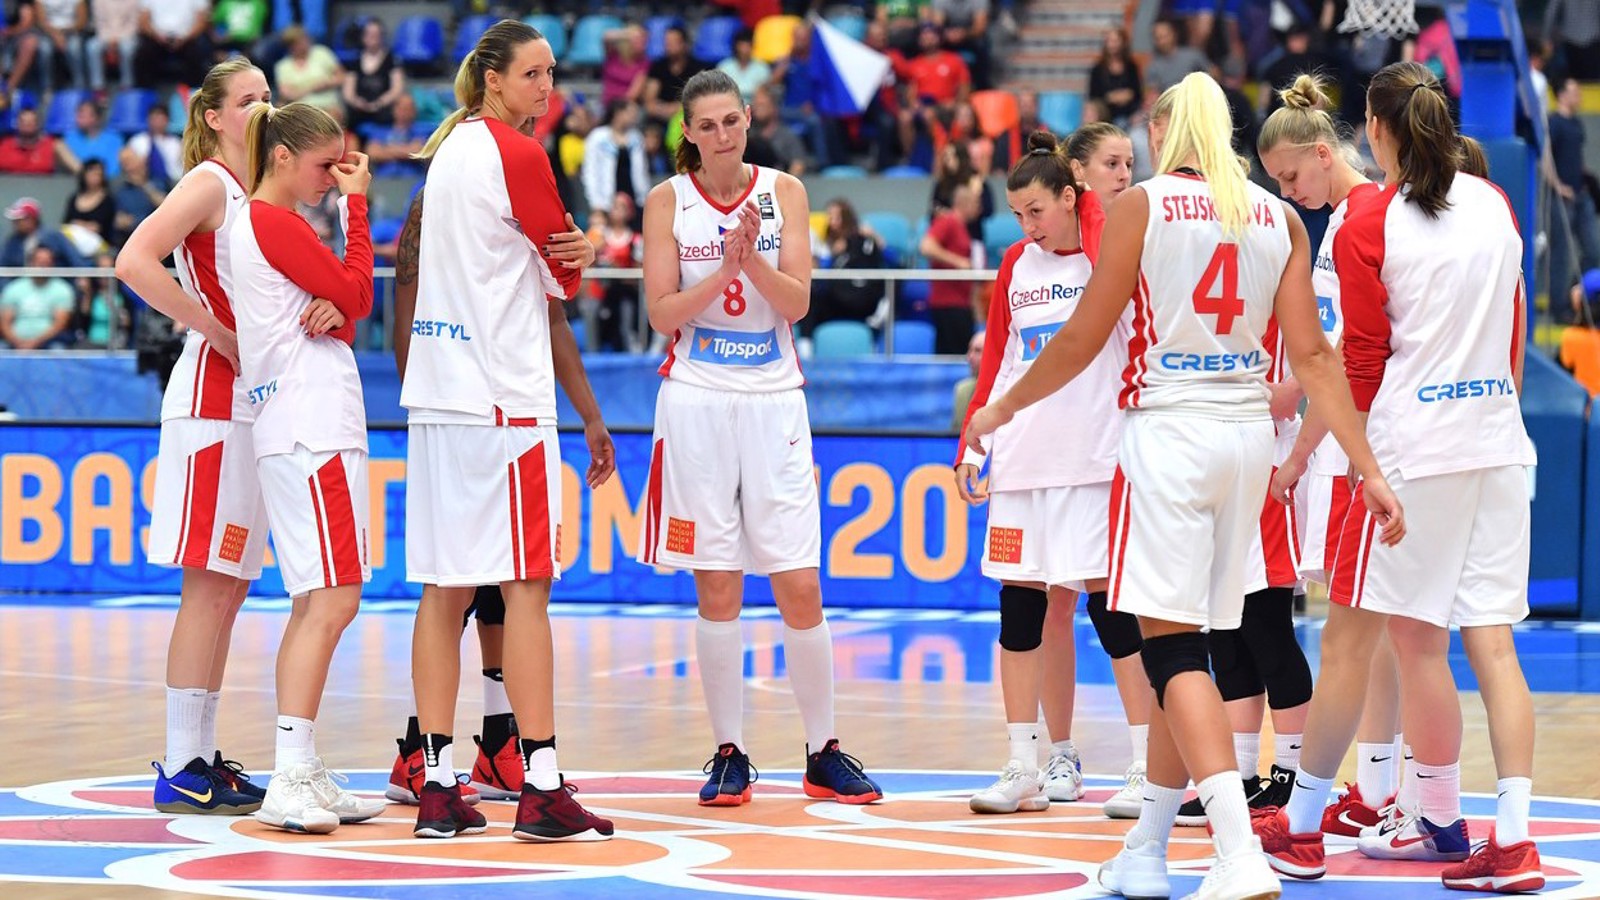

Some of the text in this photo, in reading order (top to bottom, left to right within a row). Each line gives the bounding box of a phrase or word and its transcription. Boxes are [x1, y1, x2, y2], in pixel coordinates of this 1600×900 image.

[1162, 195, 1275, 228] STEJSKVÁ
[723, 278, 746, 317] 8
[1192, 242, 1245, 335] 4
[411, 319, 472, 341] RESTYL
[247, 380, 277, 405] STYL
[1417, 379, 1513, 403] CRESTYL
[828, 462, 988, 582] 20
